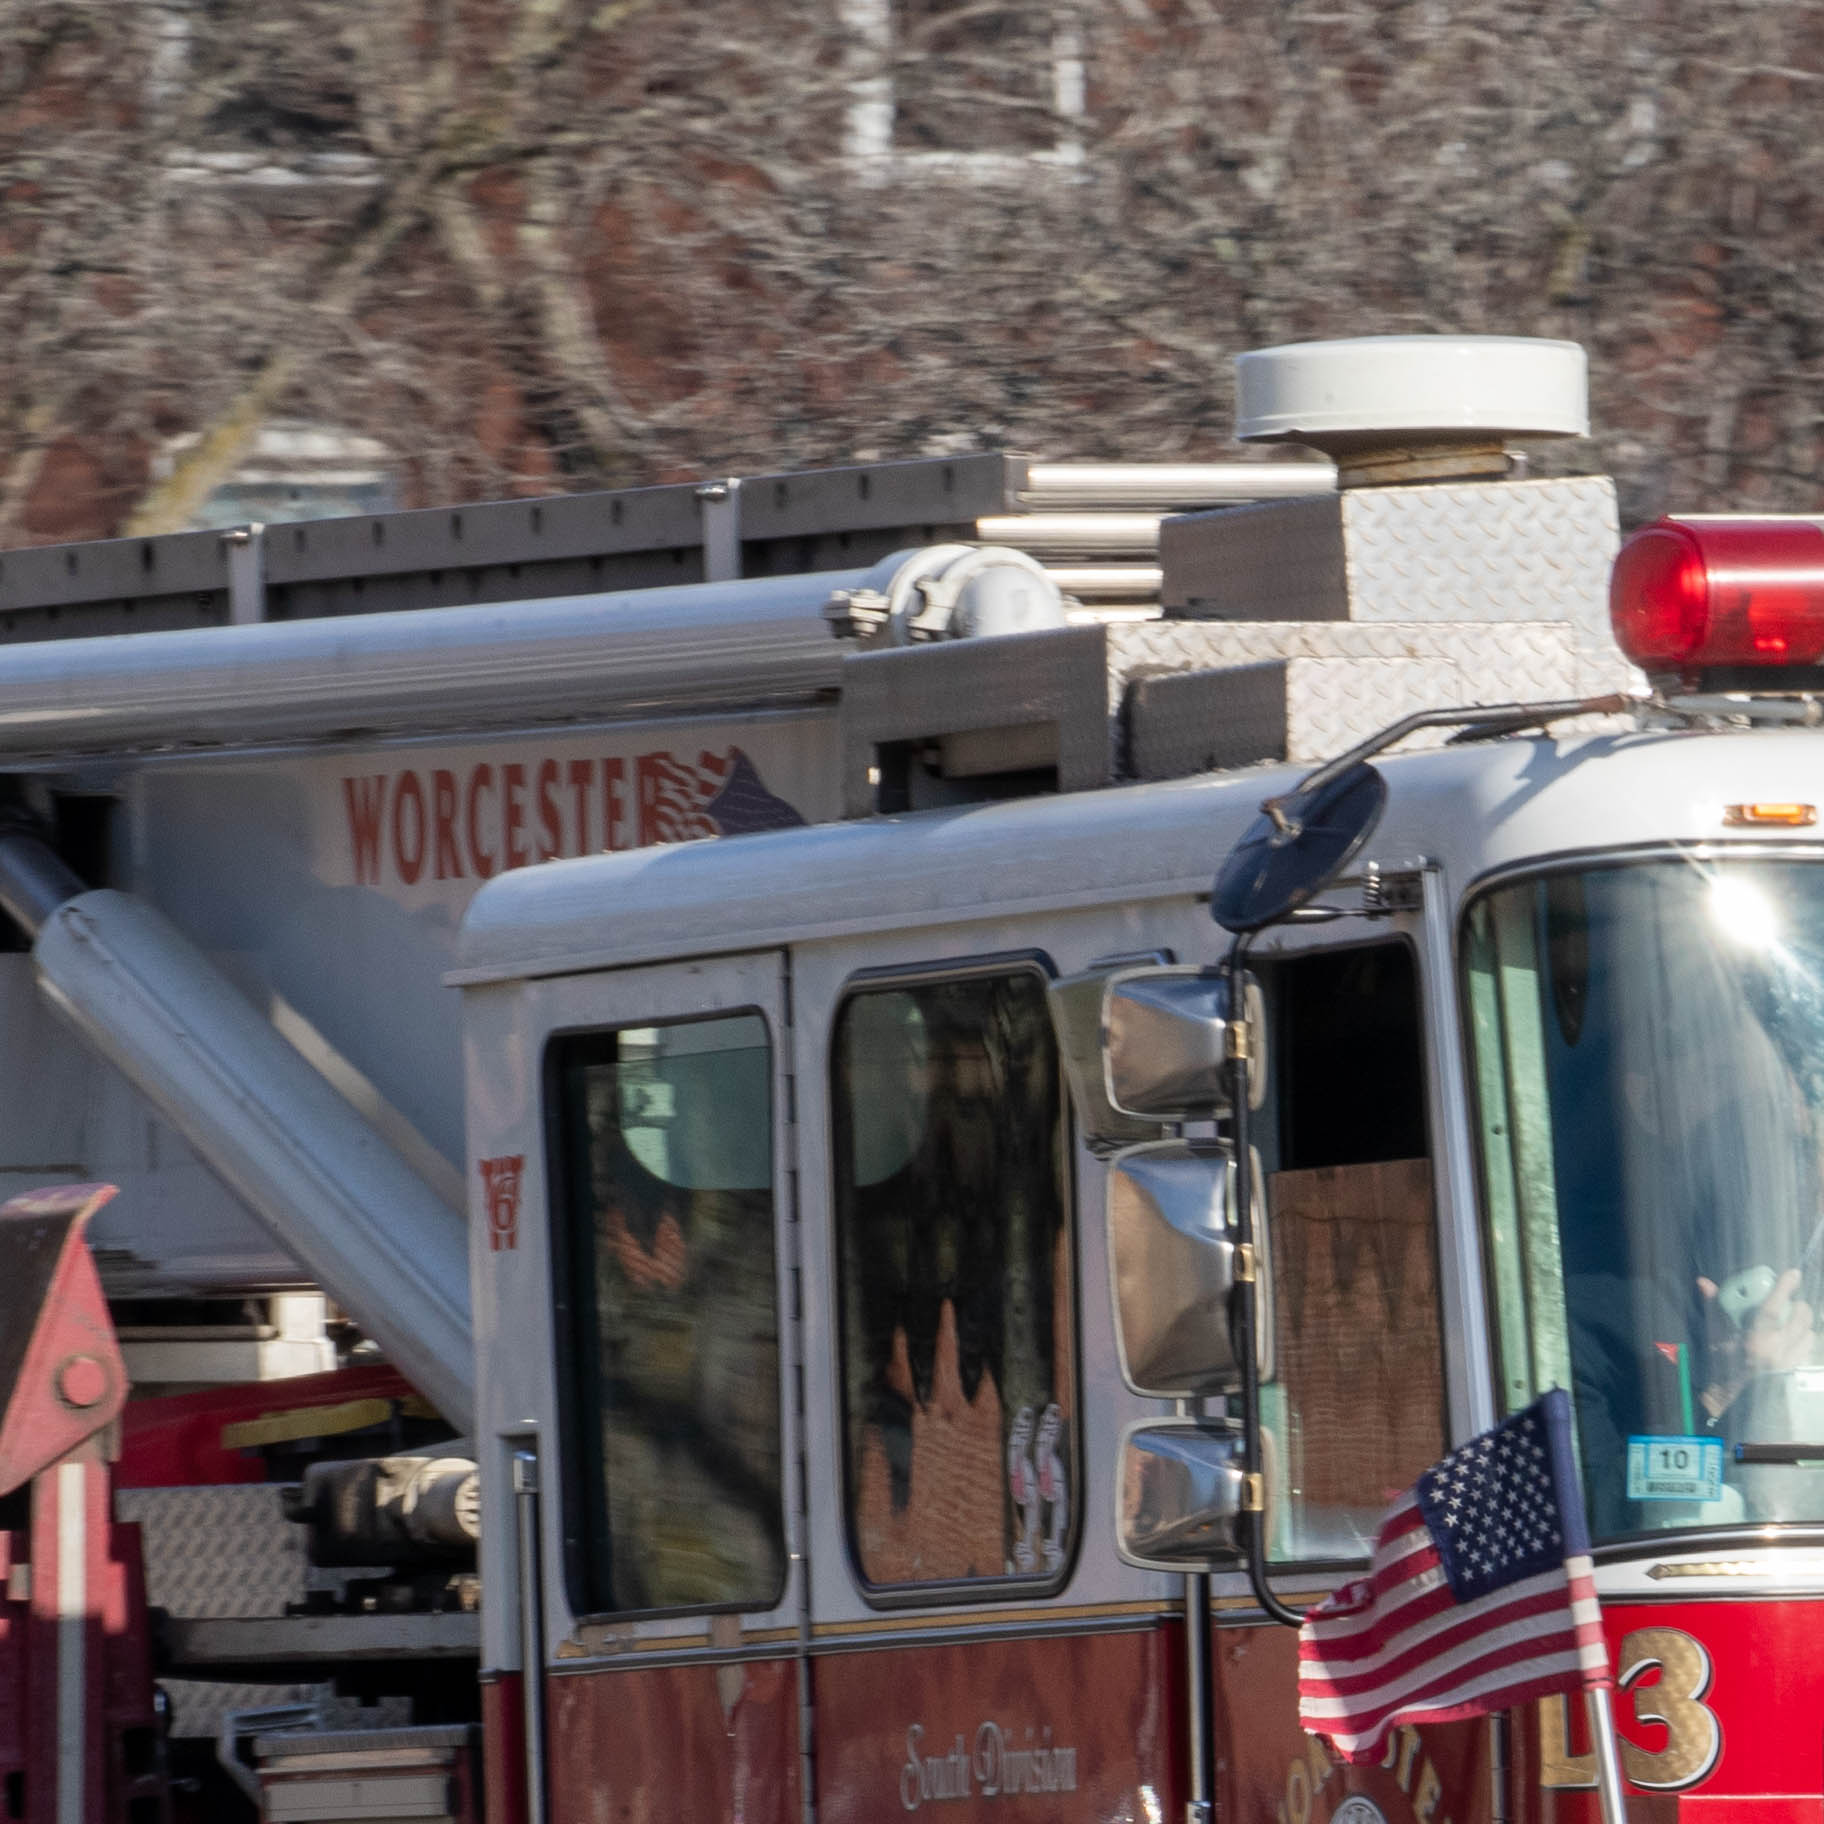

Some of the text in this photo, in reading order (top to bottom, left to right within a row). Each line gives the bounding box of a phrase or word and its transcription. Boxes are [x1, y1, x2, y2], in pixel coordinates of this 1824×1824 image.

[1659, 1449, 1689, 1470] 10
[901, 1720, 1077, 1812] South Division
